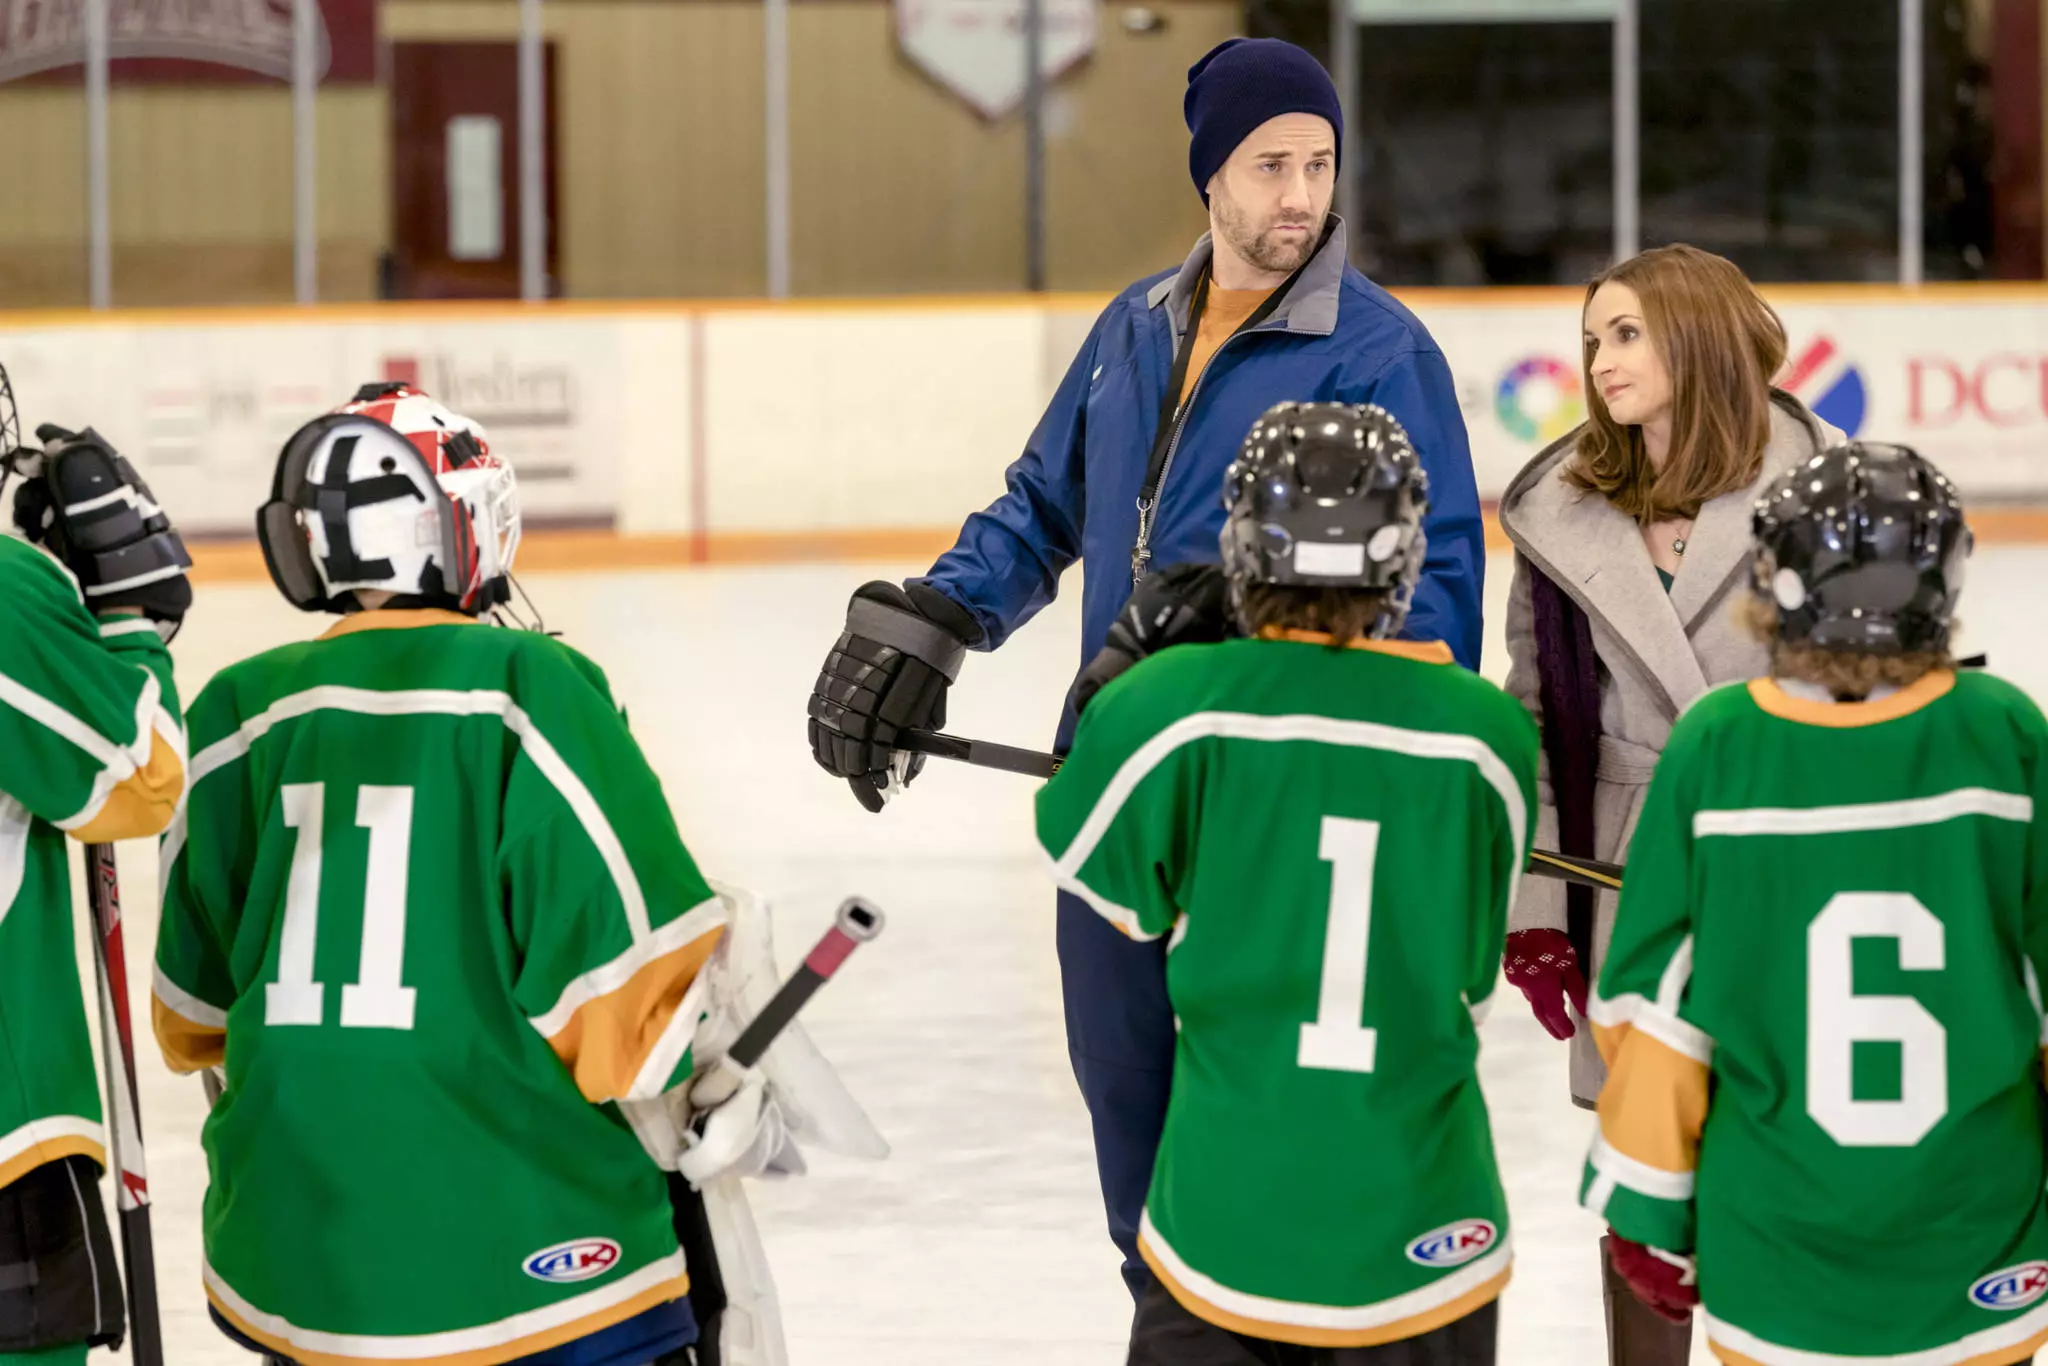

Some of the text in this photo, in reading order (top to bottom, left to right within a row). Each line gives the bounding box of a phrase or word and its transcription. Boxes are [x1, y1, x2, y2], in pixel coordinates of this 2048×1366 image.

[1906, 355, 2048, 429] DC
[265, 782, 417, 1030] 11
[1297, 815, 1380, 1073] 1
[1807, 892, 1947, 1146] 6
[529, 1243, 616, 1278] AK
[1413, 1225, 1491, 1261] AK
